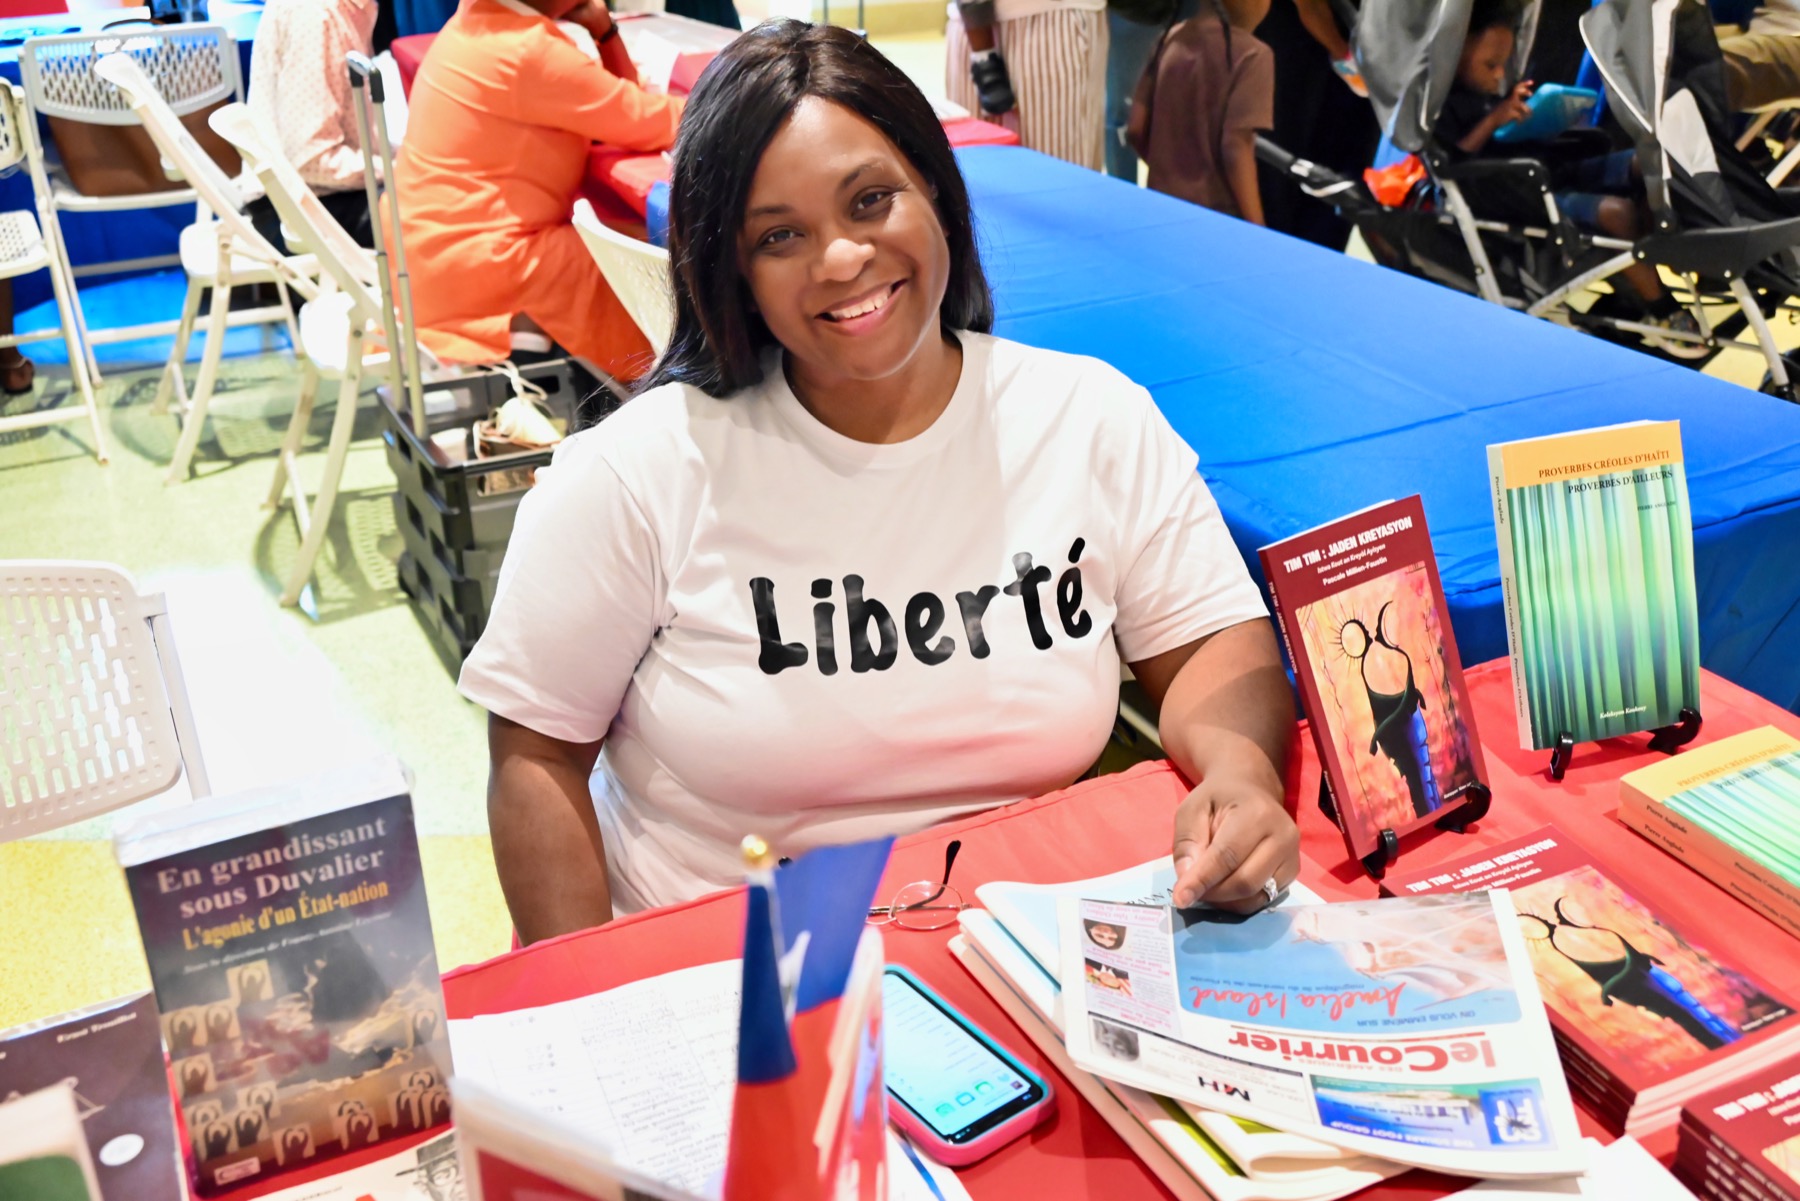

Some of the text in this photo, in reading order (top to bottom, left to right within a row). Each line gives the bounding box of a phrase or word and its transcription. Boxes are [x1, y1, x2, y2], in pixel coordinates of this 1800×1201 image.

[1538, 450, 1670, 478] PROVERBES CRÉOLES D'HAÏTI
[1568, 470, 1674, 494] PROVERBES D'AILLEURS
[1283, 556, 1303, 573] TIM
[1302, 549, 1322, 566] TIM
[1328, 535, 1358, 557] JADEN
[1357, 516, 1413, 546] KREYASYON
[1322, 572, 1346, 586] Pascale
[749, 537, 1093, 676] Liberté
[156, 817, 386, 895] En grandissant
[1405, 880, 1433, 893] TIM
[1428, 873, 1454, 886] TIM
[1459, 860, 1497, 878] JADEN
[1492, 838, 1558, 866] KREYASYON
[179, 850, 384, 918] sous Duvalier
[182, 881, 389, 951] L'agonie d'un État-nation
[1189, 986, 1287, 1020] Island
[1296, 981, 1407, 1021] Amelia
[1460, 1010, 1475, 1018] ON
[1357, 1019, 1378, 1027] SUR
[1429, 1012, 1457, 1023] VOUS
[1330, 1121, 1370, 1135] GROUP
[1372, 1128, 1403, 1140] FOOT
[1405, 1134, 1451, 1146] SQUARE
